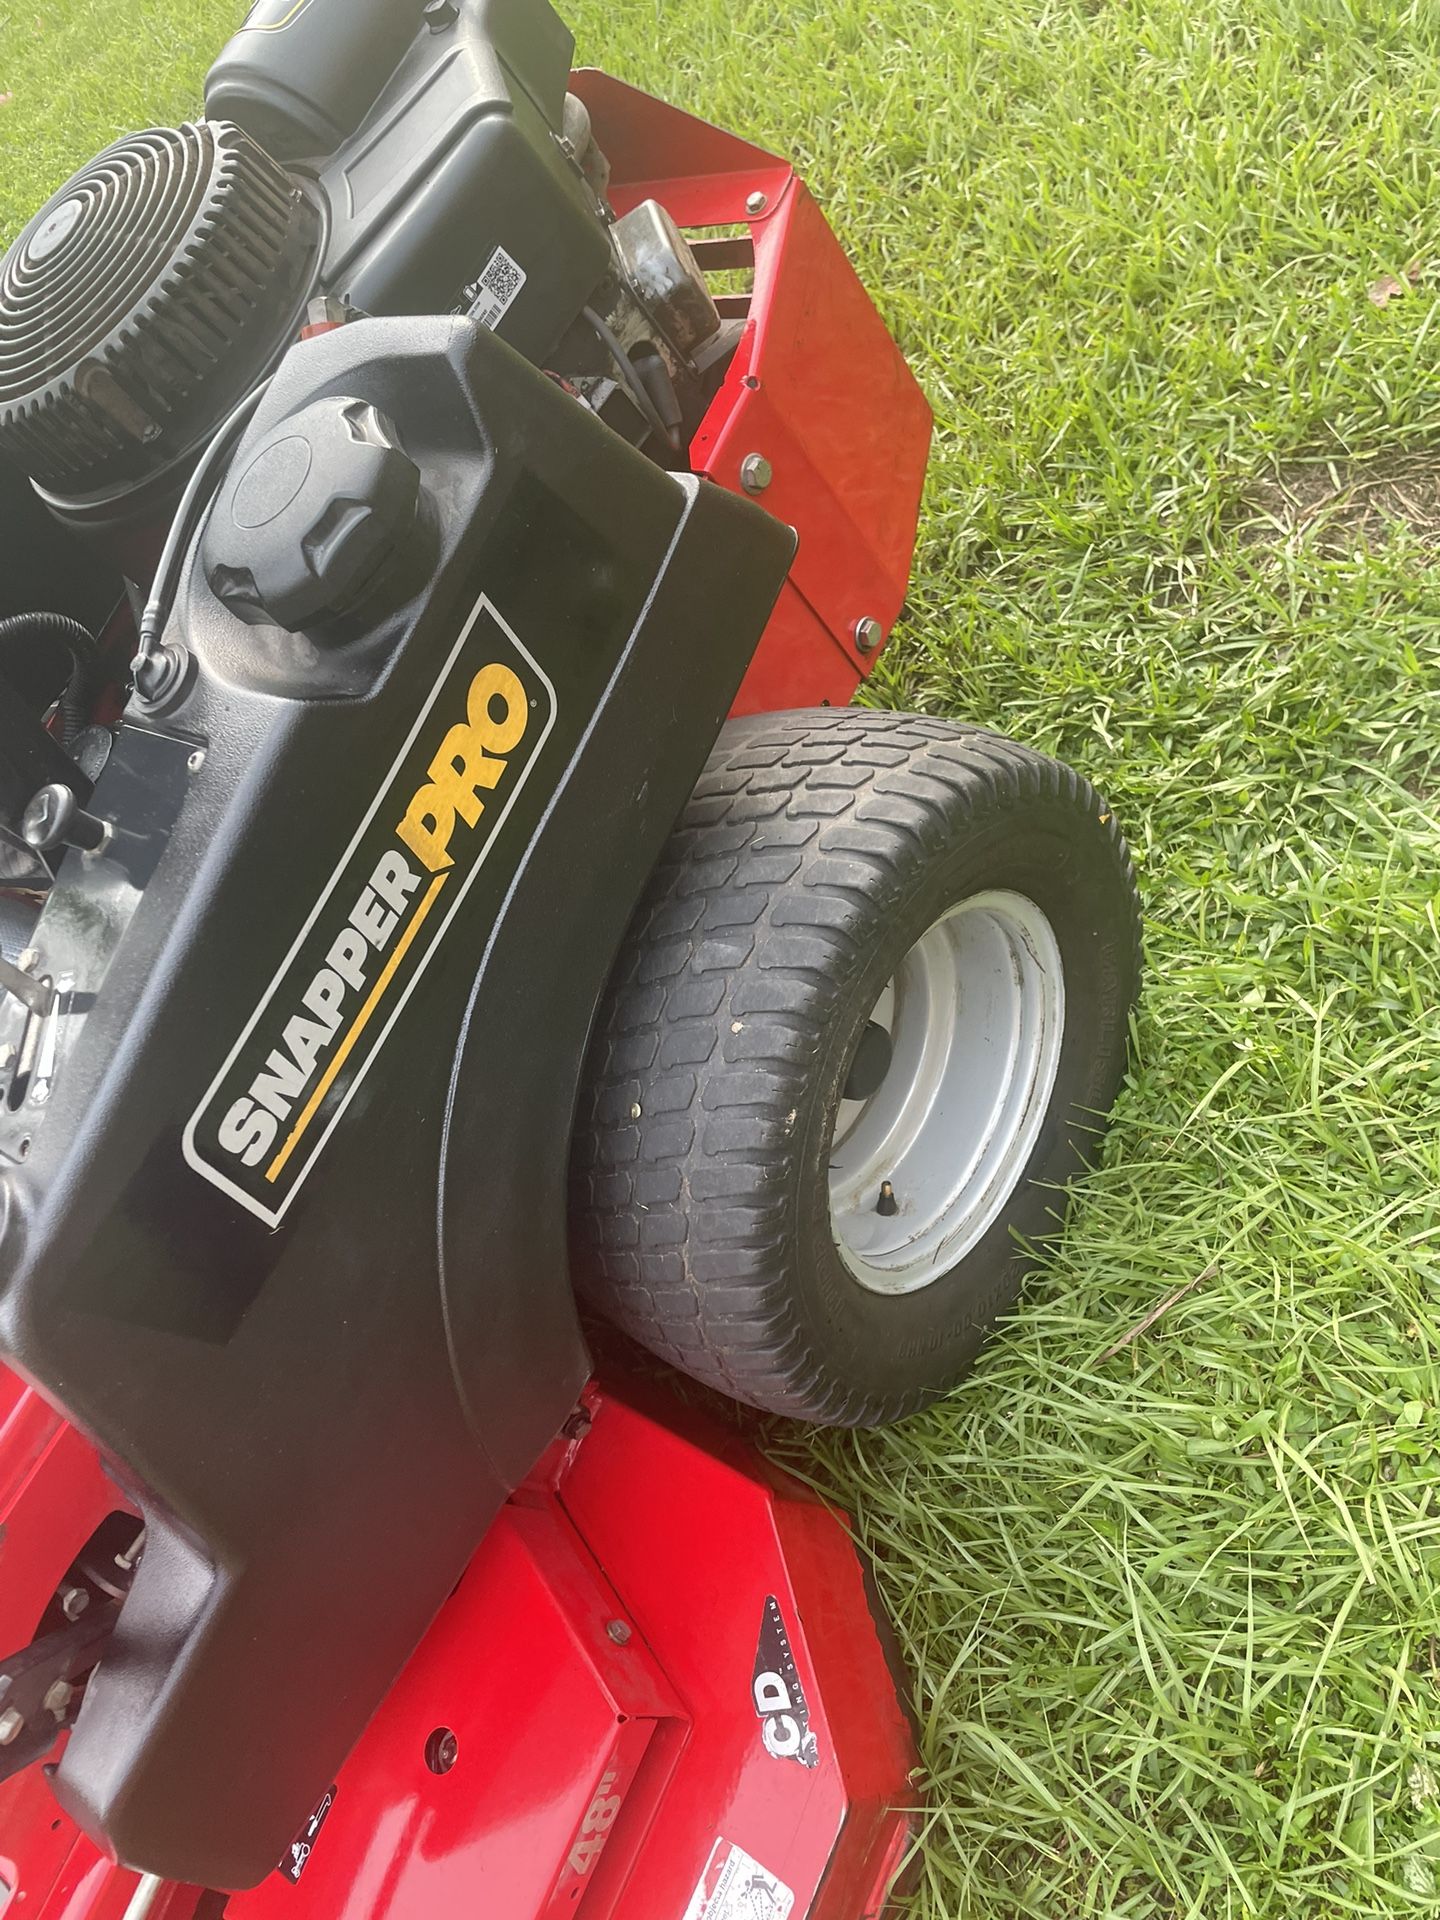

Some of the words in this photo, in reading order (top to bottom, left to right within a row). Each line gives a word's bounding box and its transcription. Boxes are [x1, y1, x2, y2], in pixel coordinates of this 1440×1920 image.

[217, 849, 422, 1167] SNAPPER
[396, 663, 528, 873] PRO
[769, 1602, 794, 1671] SYSTEM
